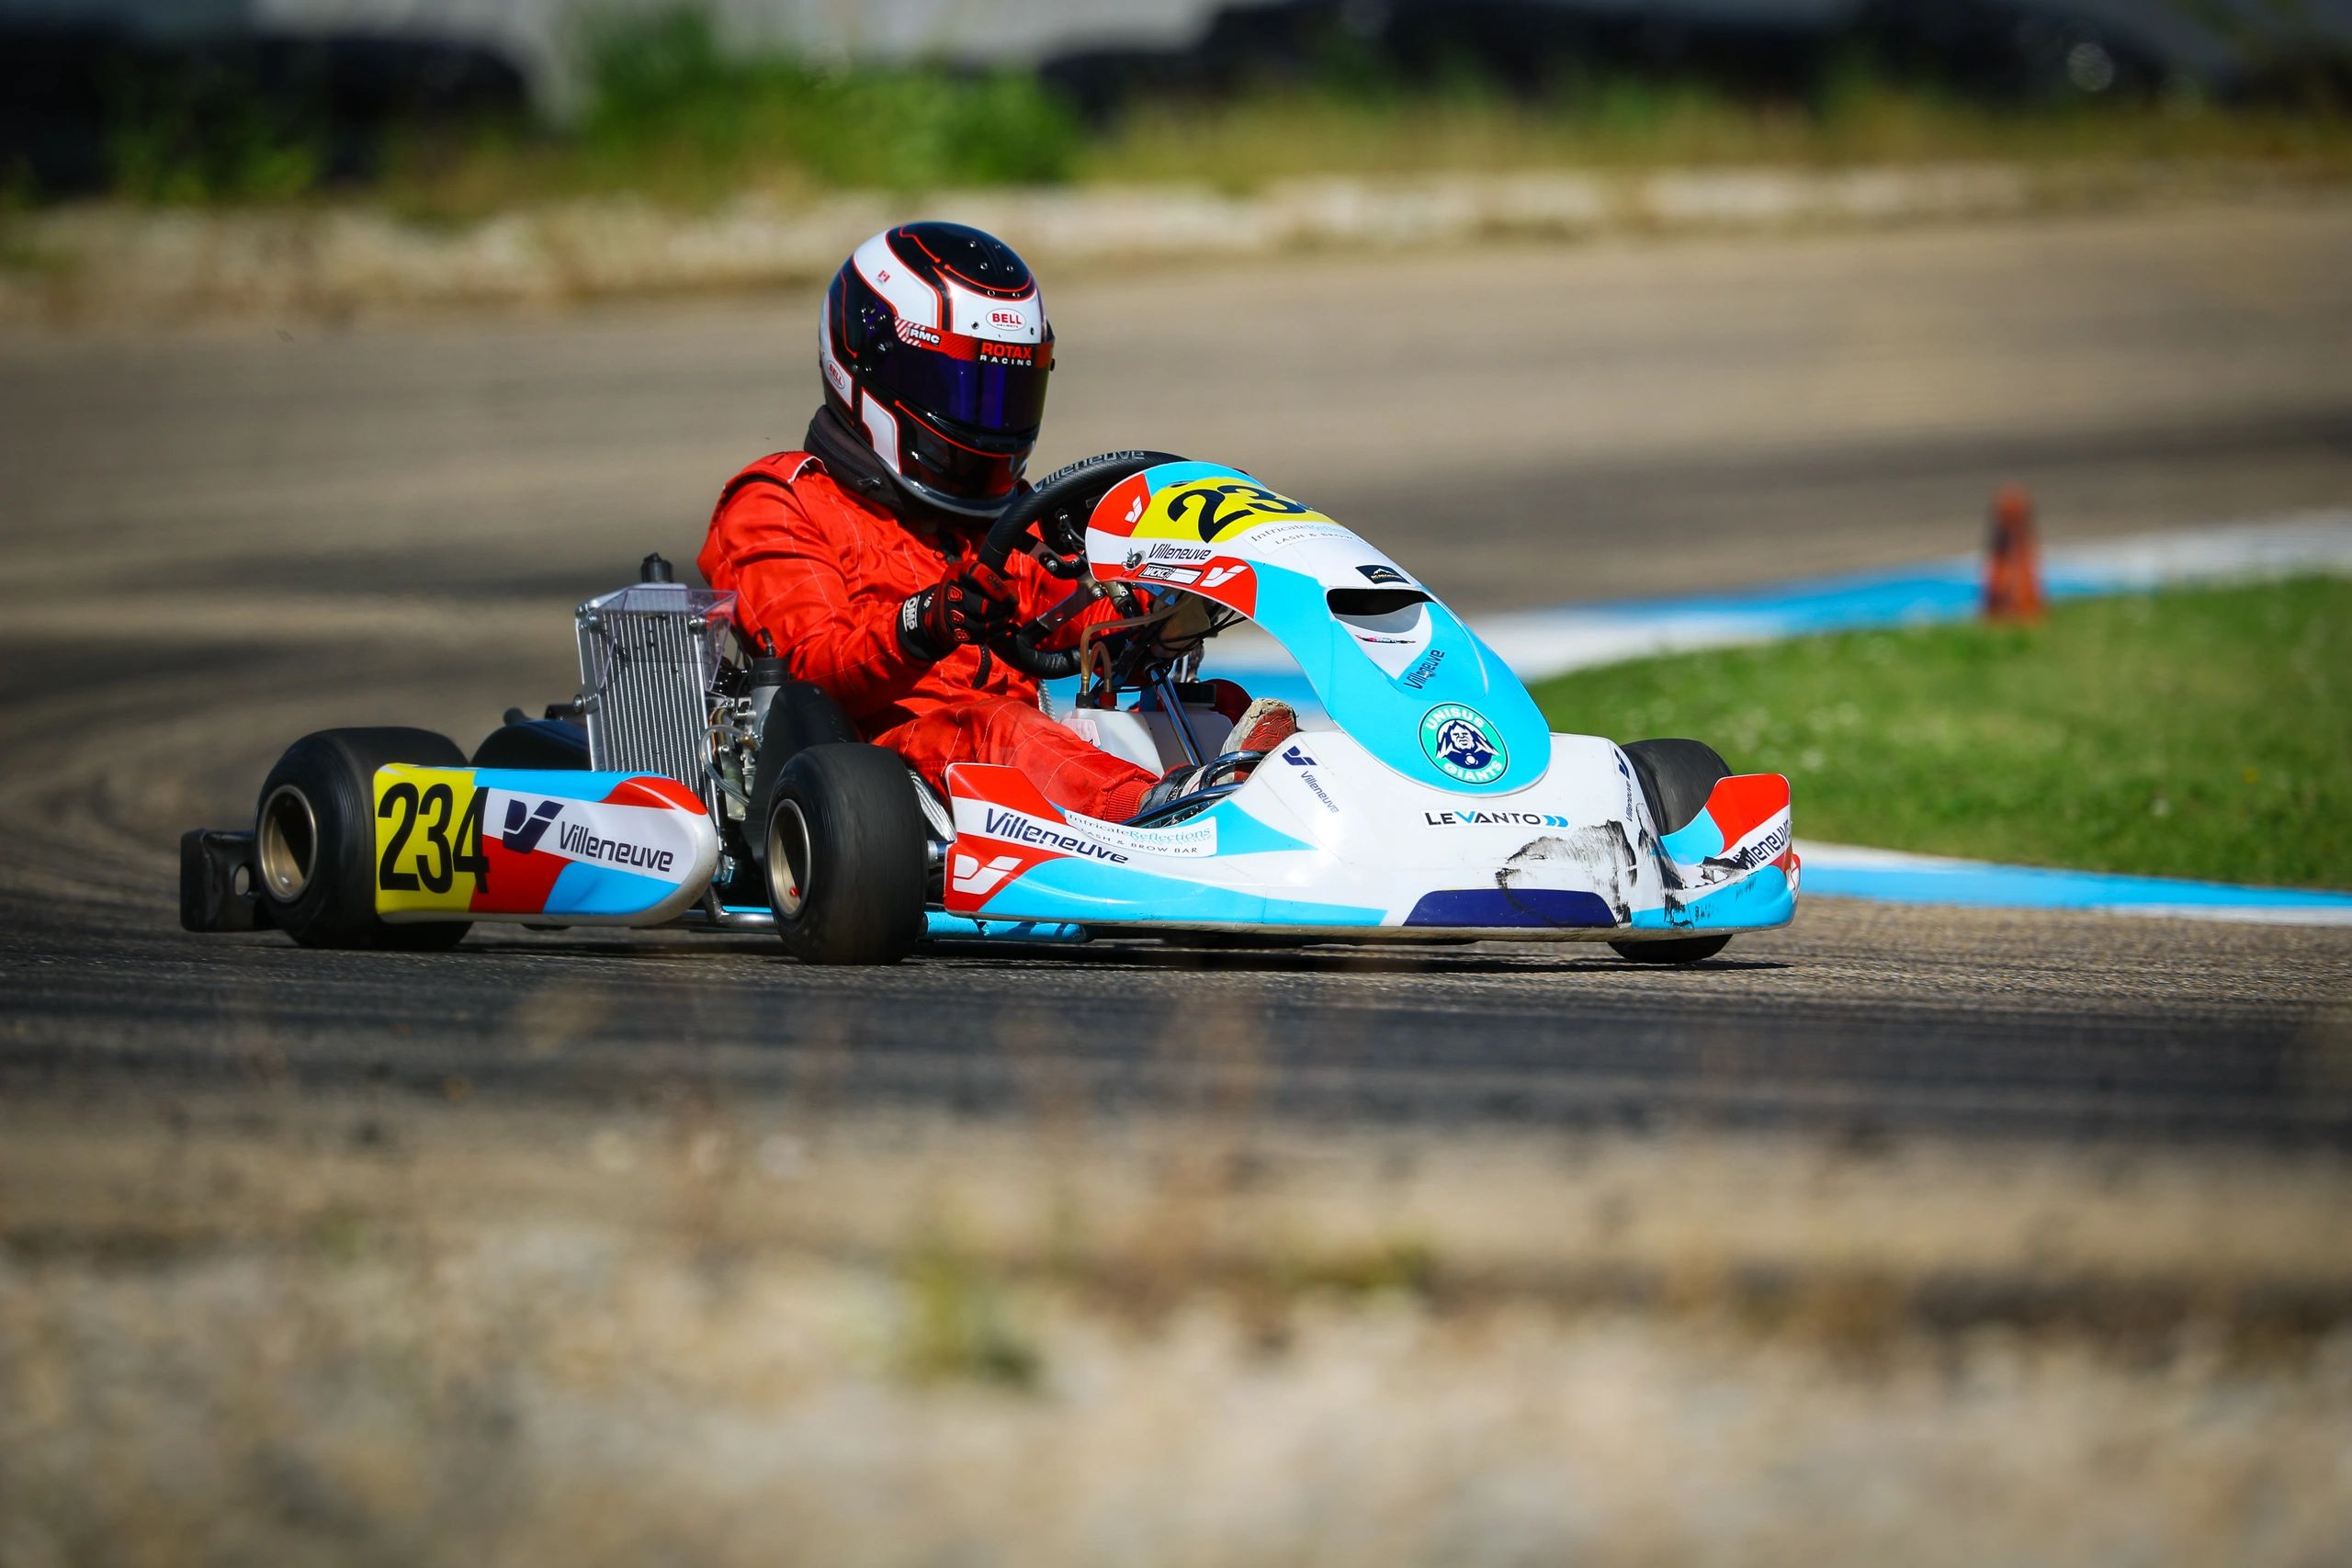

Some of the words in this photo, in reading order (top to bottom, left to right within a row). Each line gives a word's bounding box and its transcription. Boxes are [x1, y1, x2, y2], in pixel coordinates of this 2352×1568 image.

[991, 312, 1023, 325] BELL
[910, 328, 941, 344] RMC
[981, 341, 1033, 359] ROTAX
[979, 354, 1032, 367] RACING
[1148, 543, 1212, 560] Villeneuve
[1142, 564, 1172, 579] WCKC
[906, 596, 918, 631] OMP
[1425, 706, 1487, 731] UNISUS
[1443, 759, 1504, 783] GIANTS
[1300, 770, 1340, 813] Villeneuve
[1424, 810, 1542, 826] LEVANTO
[377, 782, 491, 894] 234
[985, 807, 1130, 864] Villeneuve
[560, 820, 674, 873] Villeneuve
[1131, 842, 1169, 853] BROW
